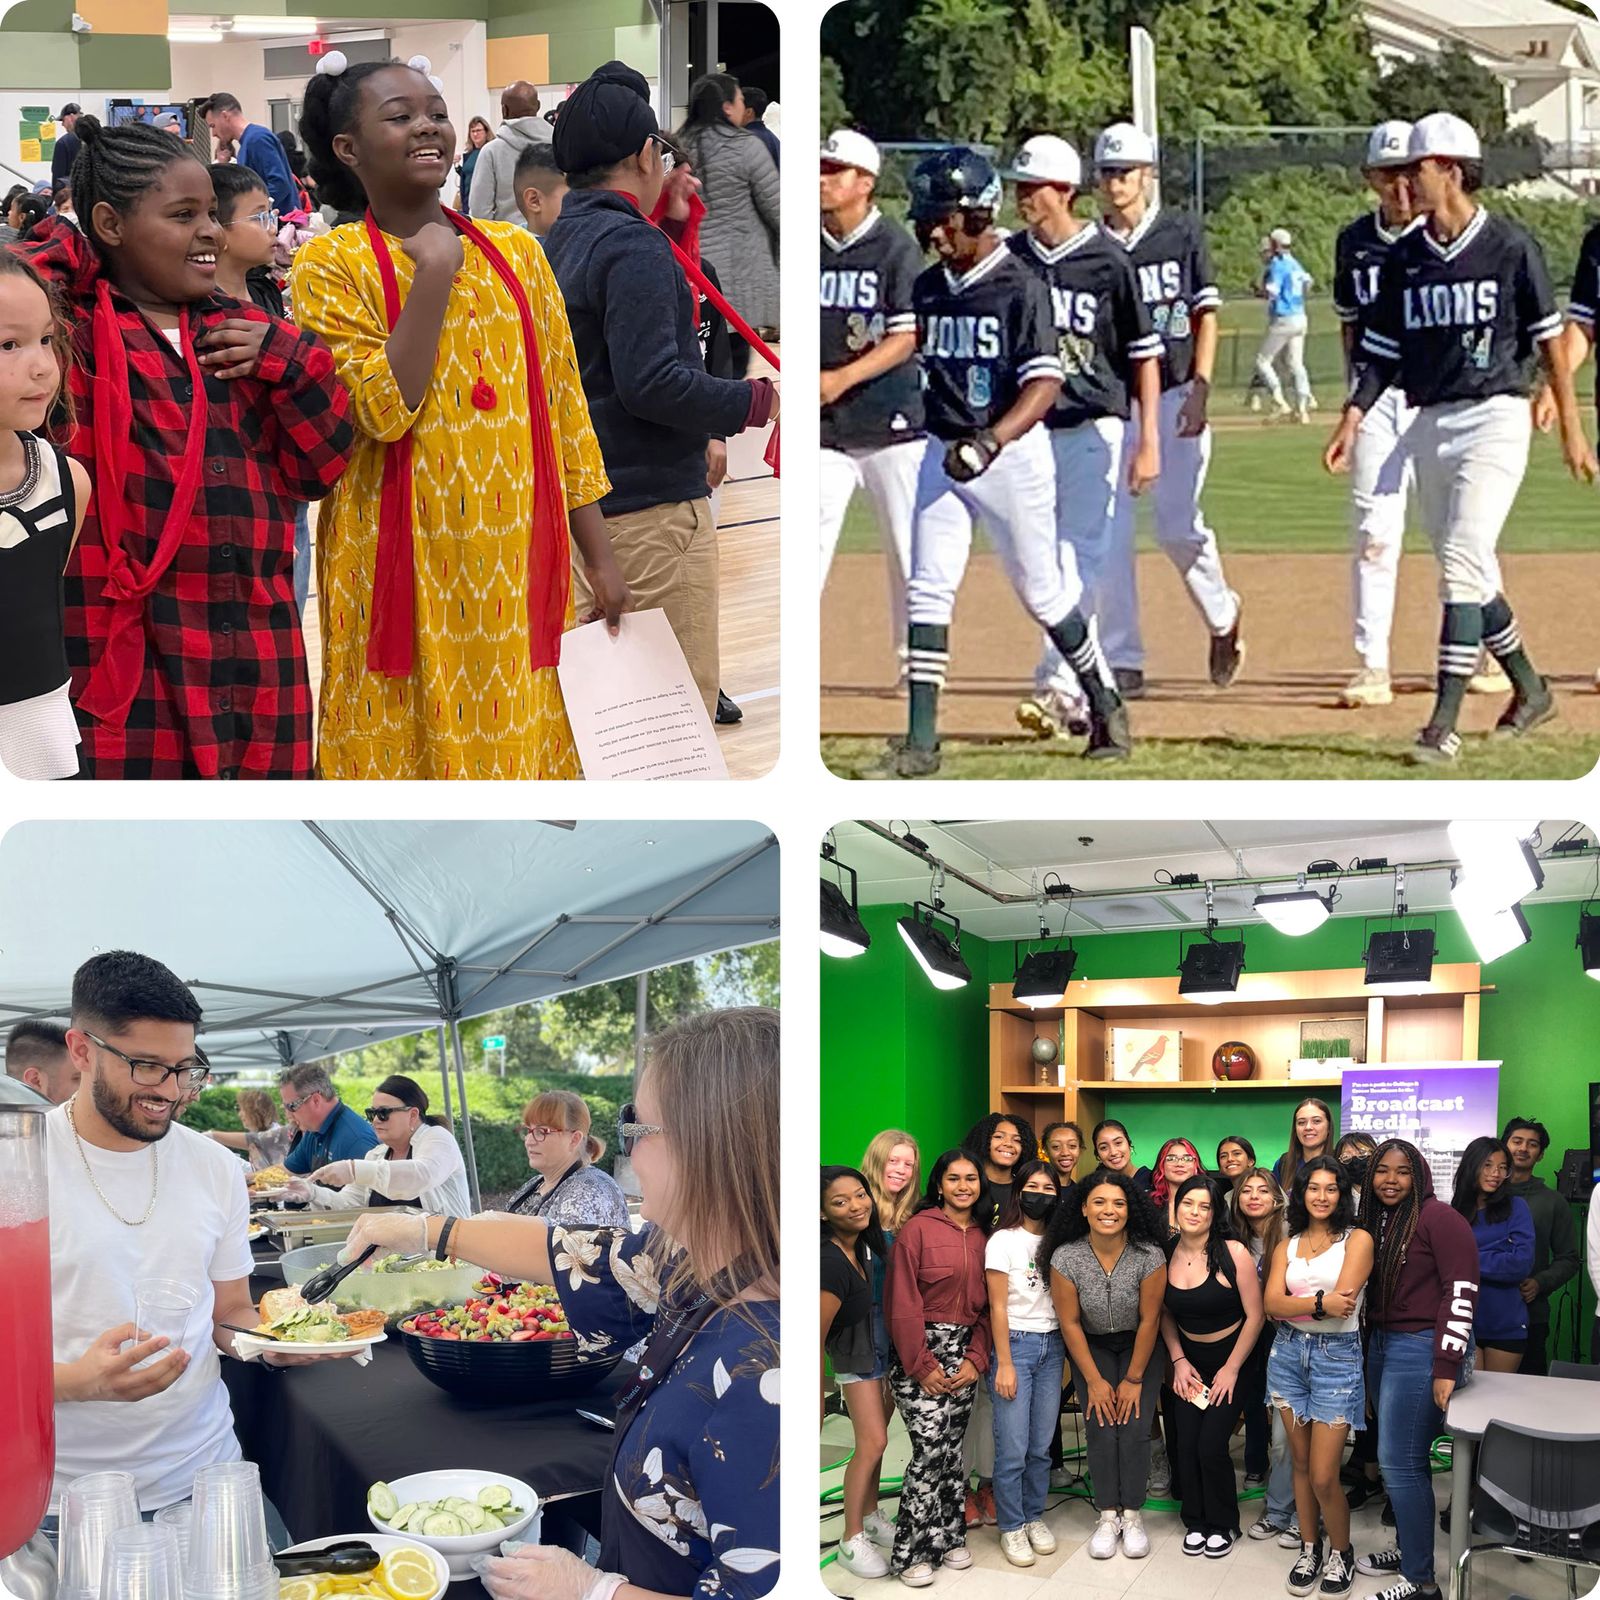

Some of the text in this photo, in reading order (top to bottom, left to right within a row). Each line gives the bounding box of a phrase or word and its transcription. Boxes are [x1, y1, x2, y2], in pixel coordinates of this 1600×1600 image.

[820, 270, 879, 308] ONS
[1403, 279, 1499, 330] LIONS
[1350, 1094, 1465, 1112] Broadcast
[1350, 1113, 1421, 1130] Media
[1441, 1280, 1479, 1356] LOVE
